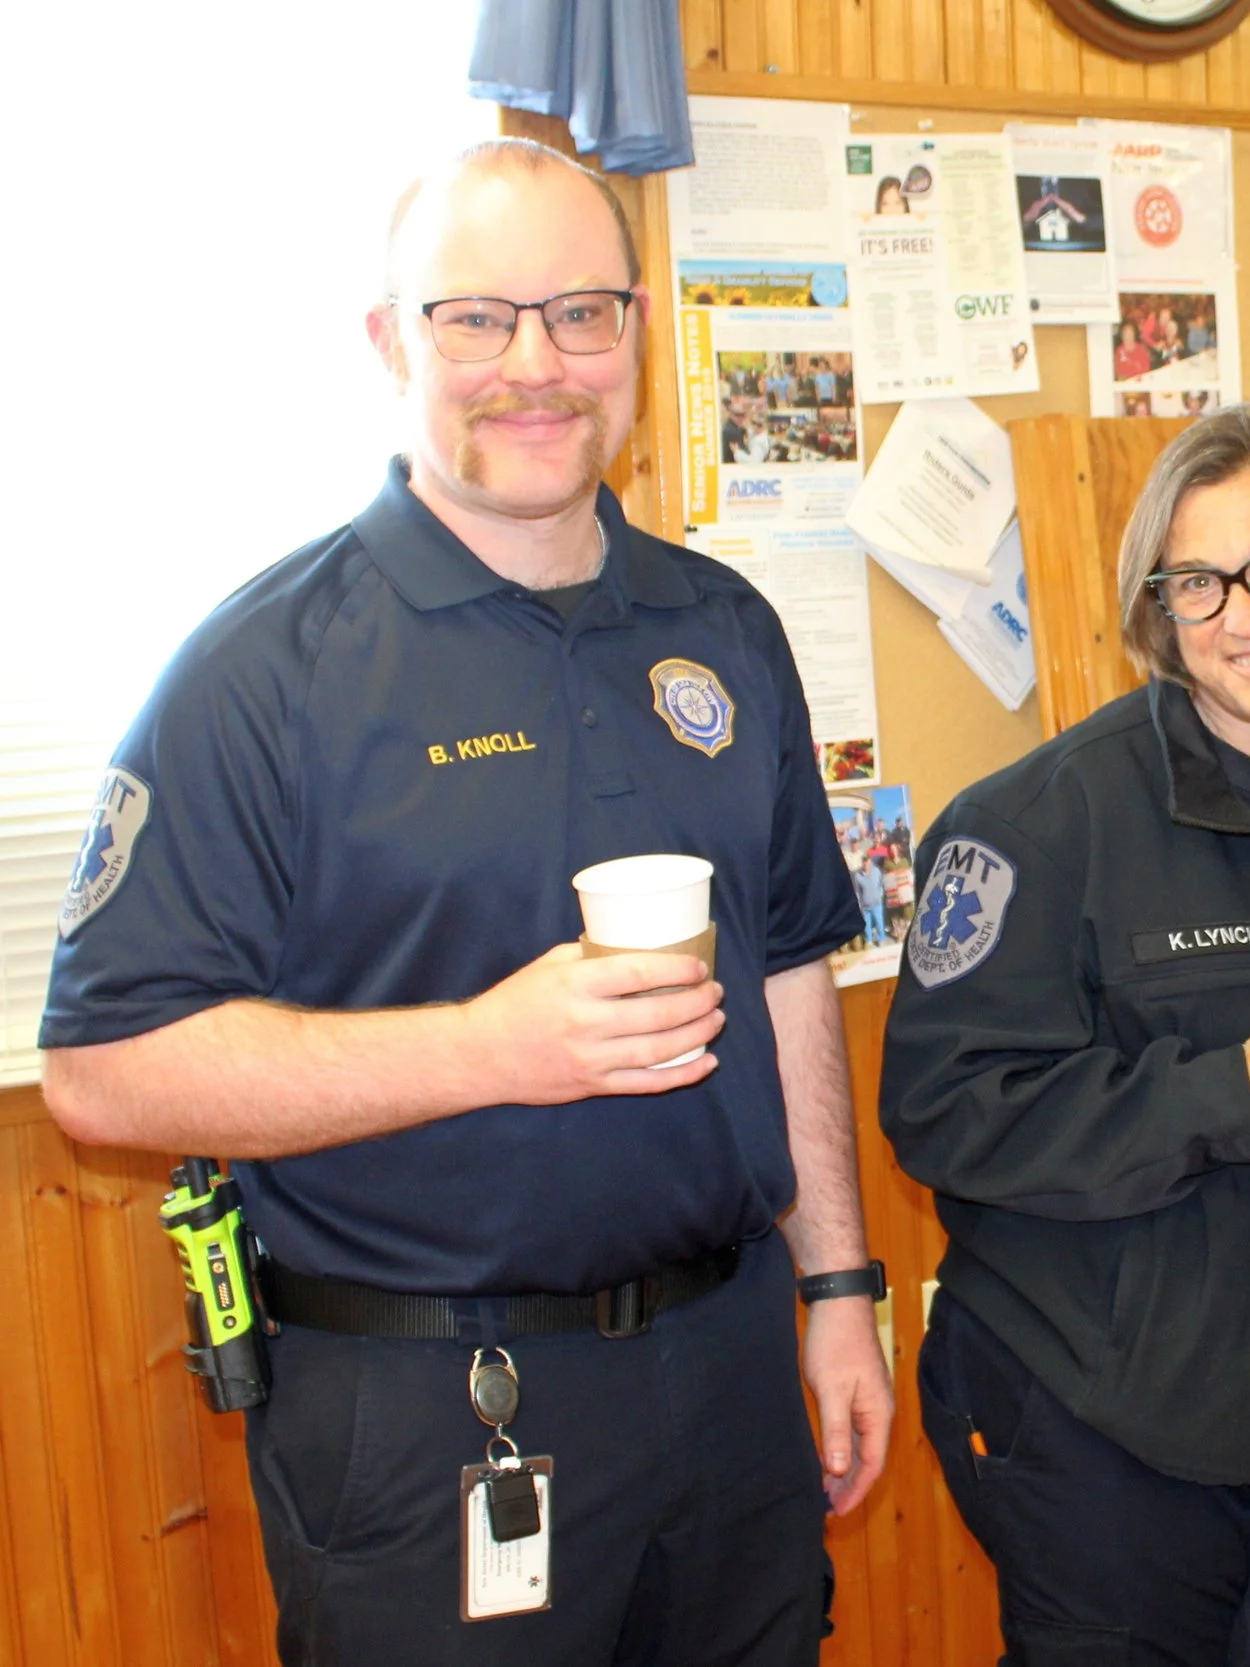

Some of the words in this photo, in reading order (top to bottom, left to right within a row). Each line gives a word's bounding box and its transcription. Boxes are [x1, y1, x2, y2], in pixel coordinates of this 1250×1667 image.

[861, 238, 888, 257] IT'S
[891, 236, 934, 254] FREE!
[726, 478, 783, 498] ADRC
[991, 600, 1029, 643] ADRC
[427, 744, 455, 765] B.
[456, 730, 537, 761] KNOLL
[93, 854, 125, 903] HEALTH
[933, 843, 1001, 885] EMT
[917, 957, 946, 974] DEPT.
[948, 957, 964, 972] OF
[963, 919, 996, 962] HEALTH
[917, 941, 960, 962] CERTIFIED
